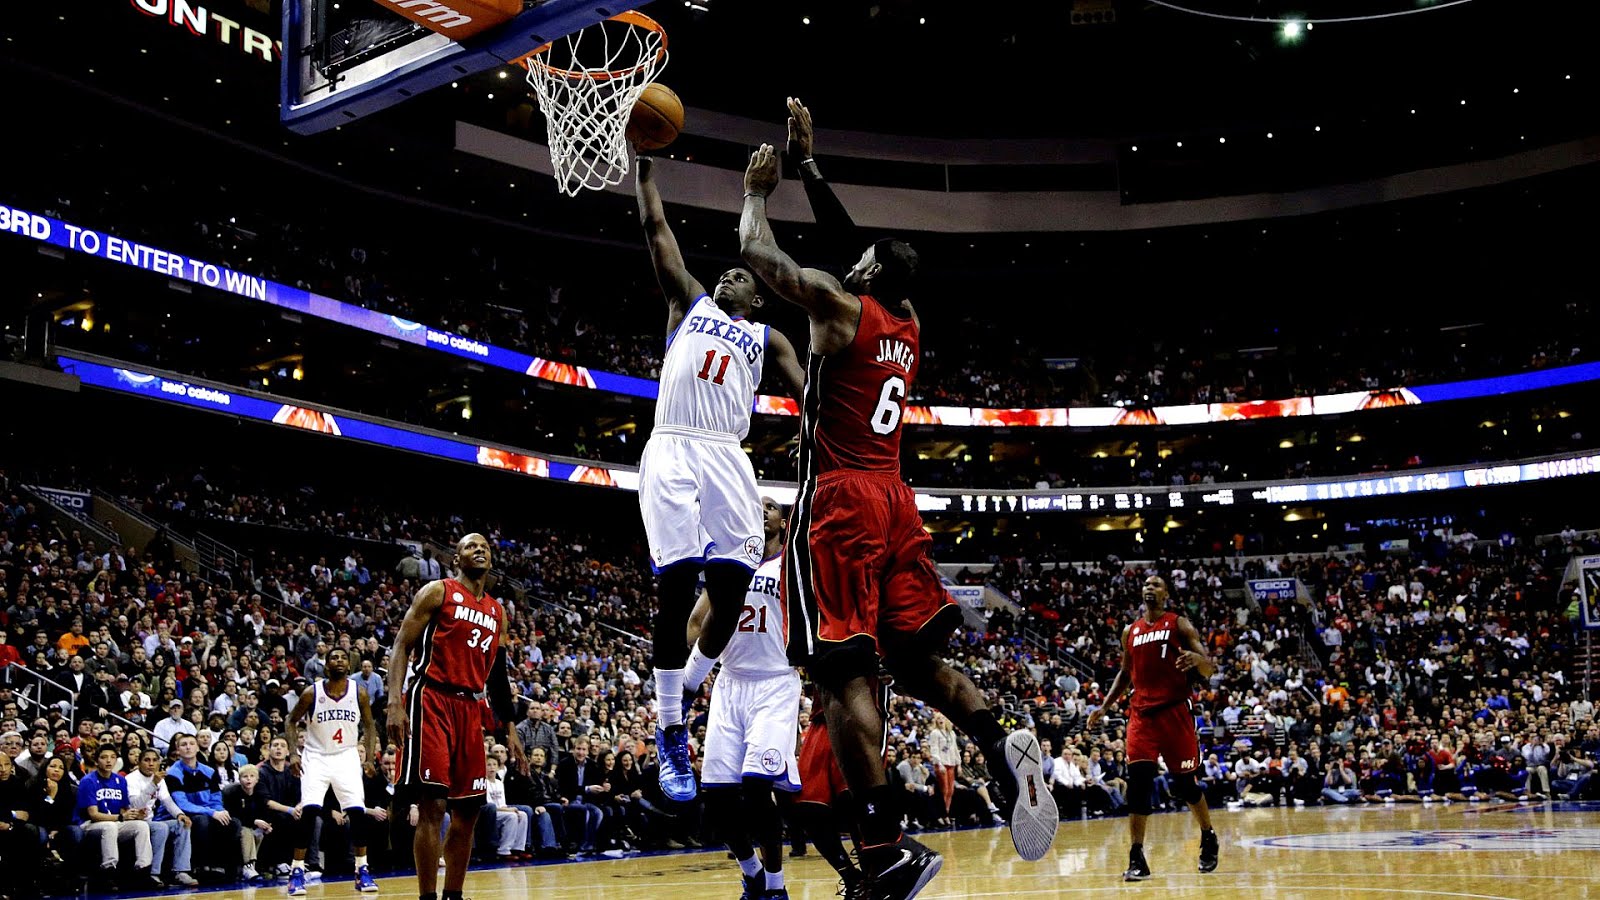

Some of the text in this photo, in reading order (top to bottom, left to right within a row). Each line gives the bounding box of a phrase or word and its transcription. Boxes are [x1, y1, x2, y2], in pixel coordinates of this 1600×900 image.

[65, 224, 100, 254] TO
[106, 236, 184, 278] ENTER
[188, 259, 220, 287] TO
[225, 269, 266, 301] WIN
[686, 315, 762, 364] SIXERS
[697, 349, 731, 386] 11
[876, 339, 914, 373] JAMES
[870, 376, 905, 435] 6
[454, 605, 497, 633] MIAMI
[738, 604, 767, 633] 21
[467, 628, 493, 653] 34
[1133, 629, 1170, 647] MIAMI
[1161, 643, 1167, 658] 1
[317, 709, 356, 723] SIXERS
[332, 728, 343, 744] 4
